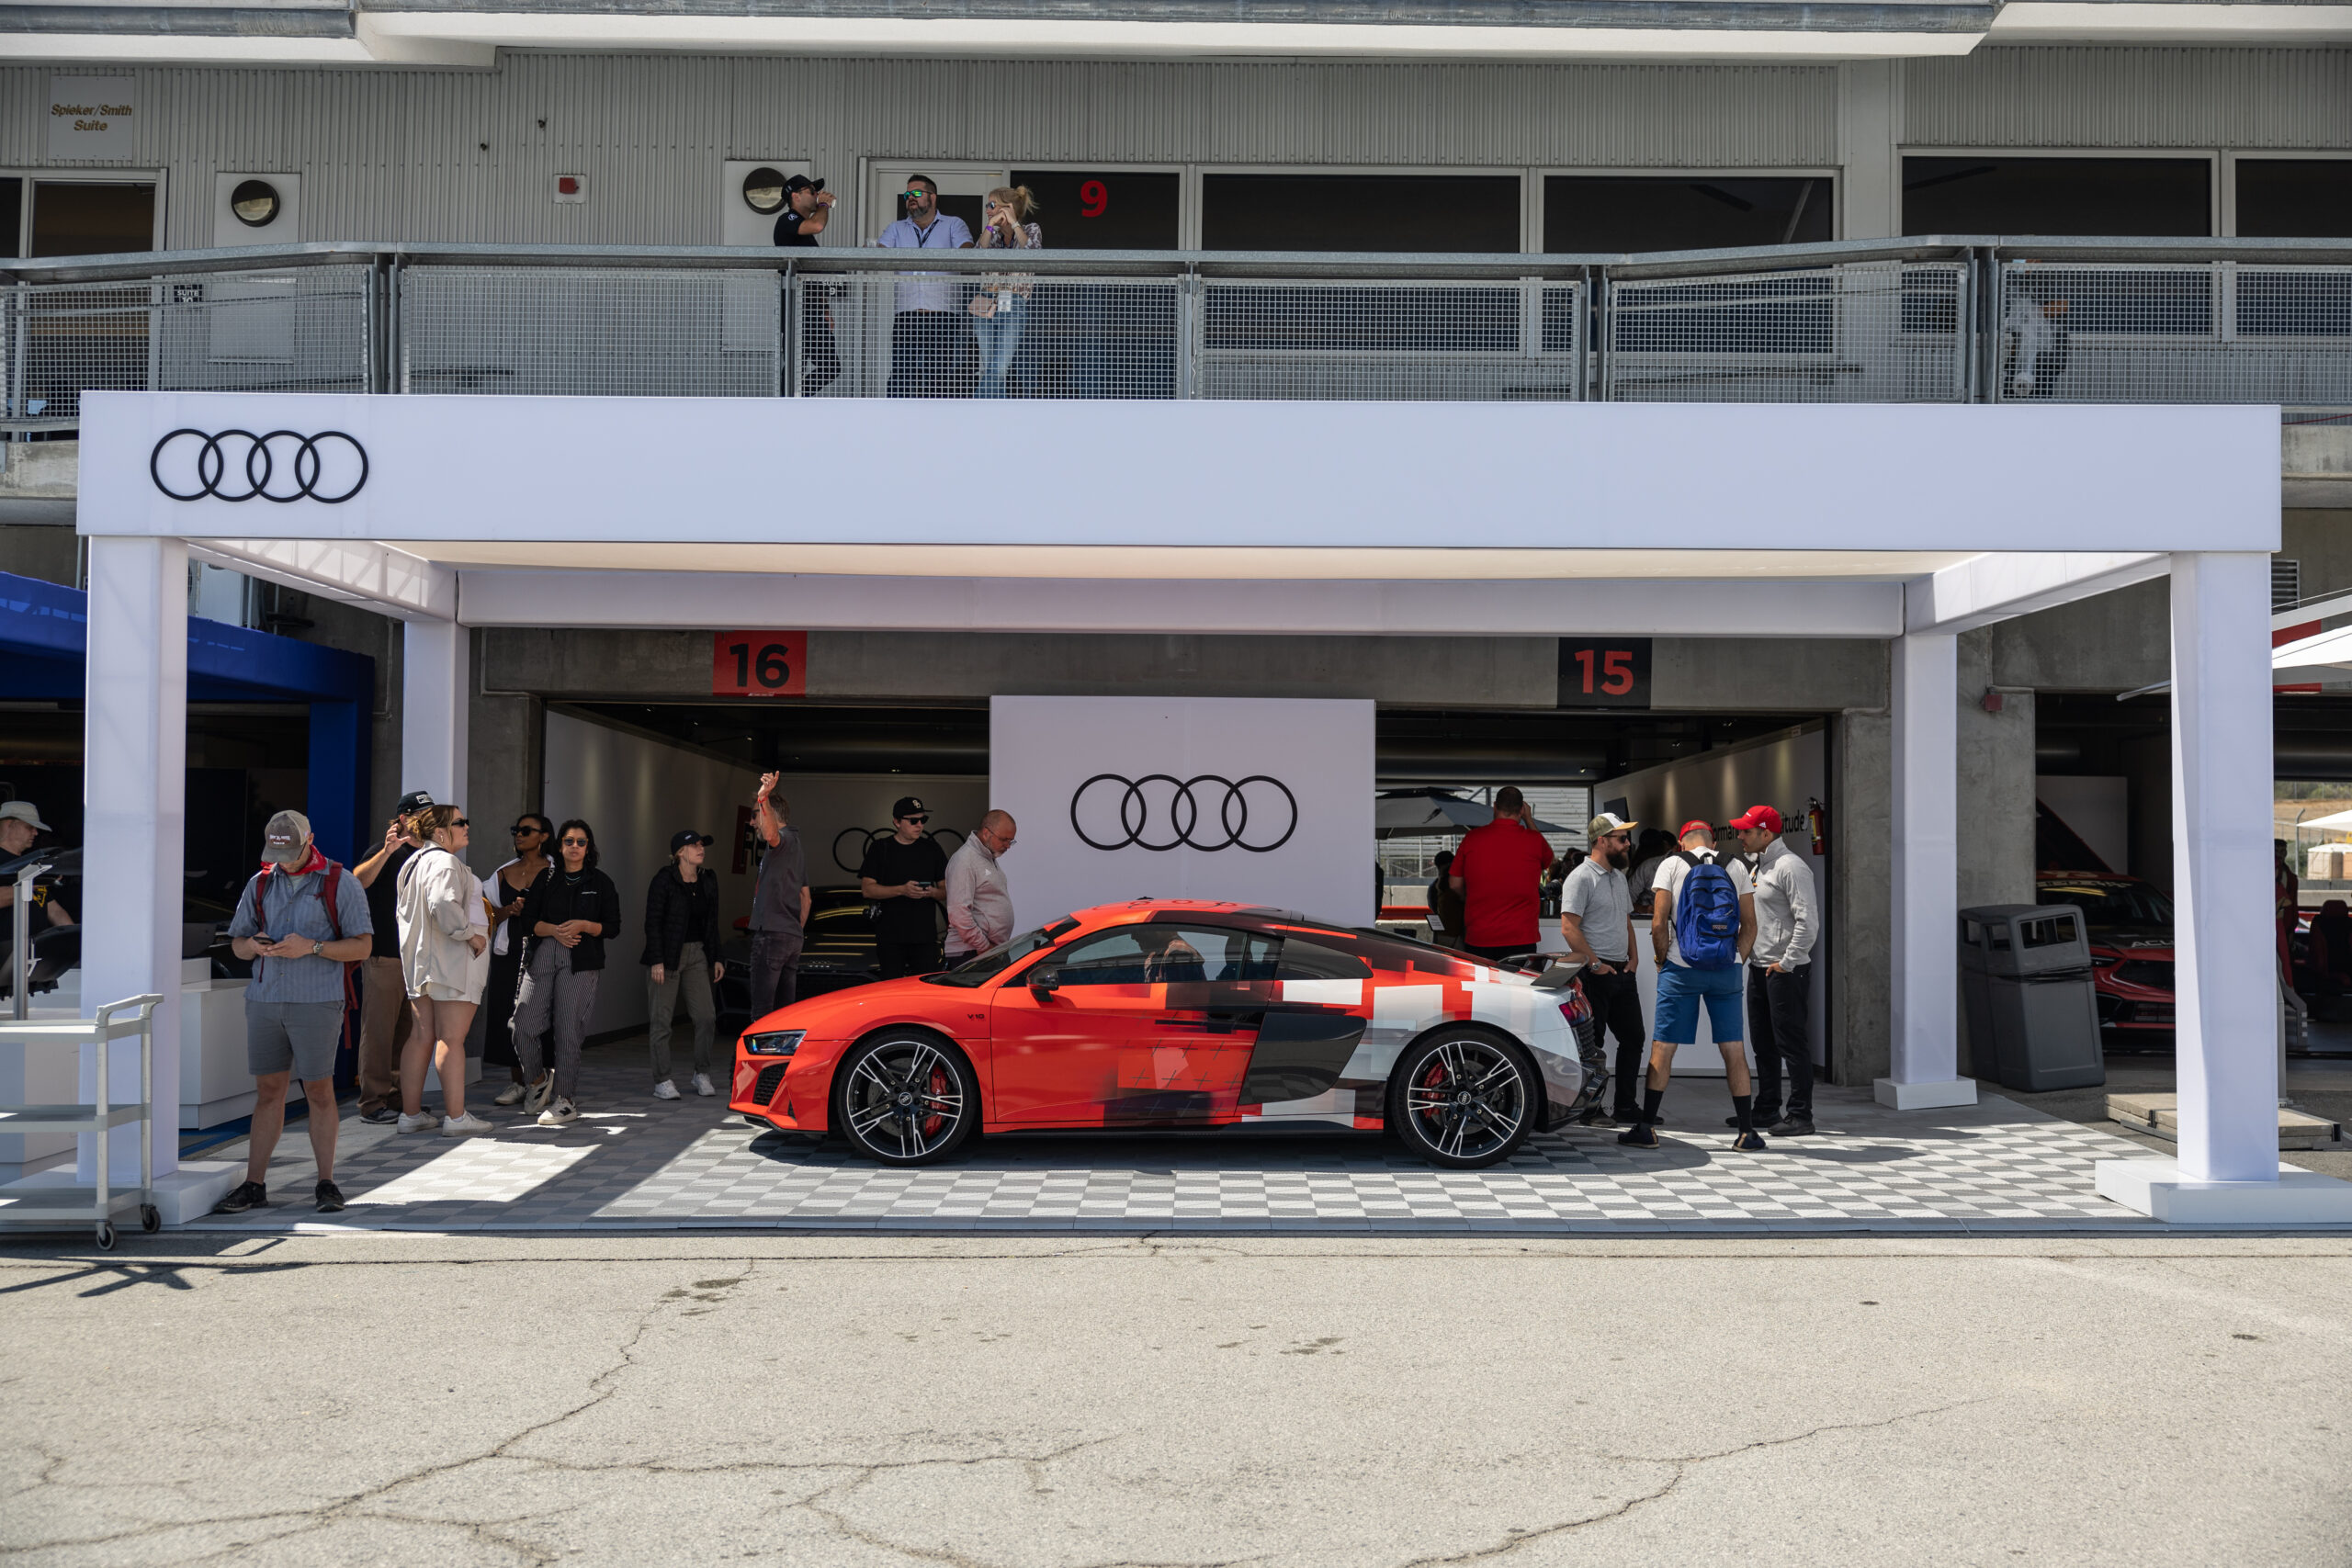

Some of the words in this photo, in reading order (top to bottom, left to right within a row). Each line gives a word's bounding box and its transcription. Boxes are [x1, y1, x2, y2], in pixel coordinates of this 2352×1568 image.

[51, 103, 132, 118] Spieker/Smith
[74, 119, 108, 131] Suite
[1080, 179, 1108, 217] 9
[830, 287, 836, 296] 9
[729, 644, 789, 688] 16
[1574, 649, 1634, 695] 15
